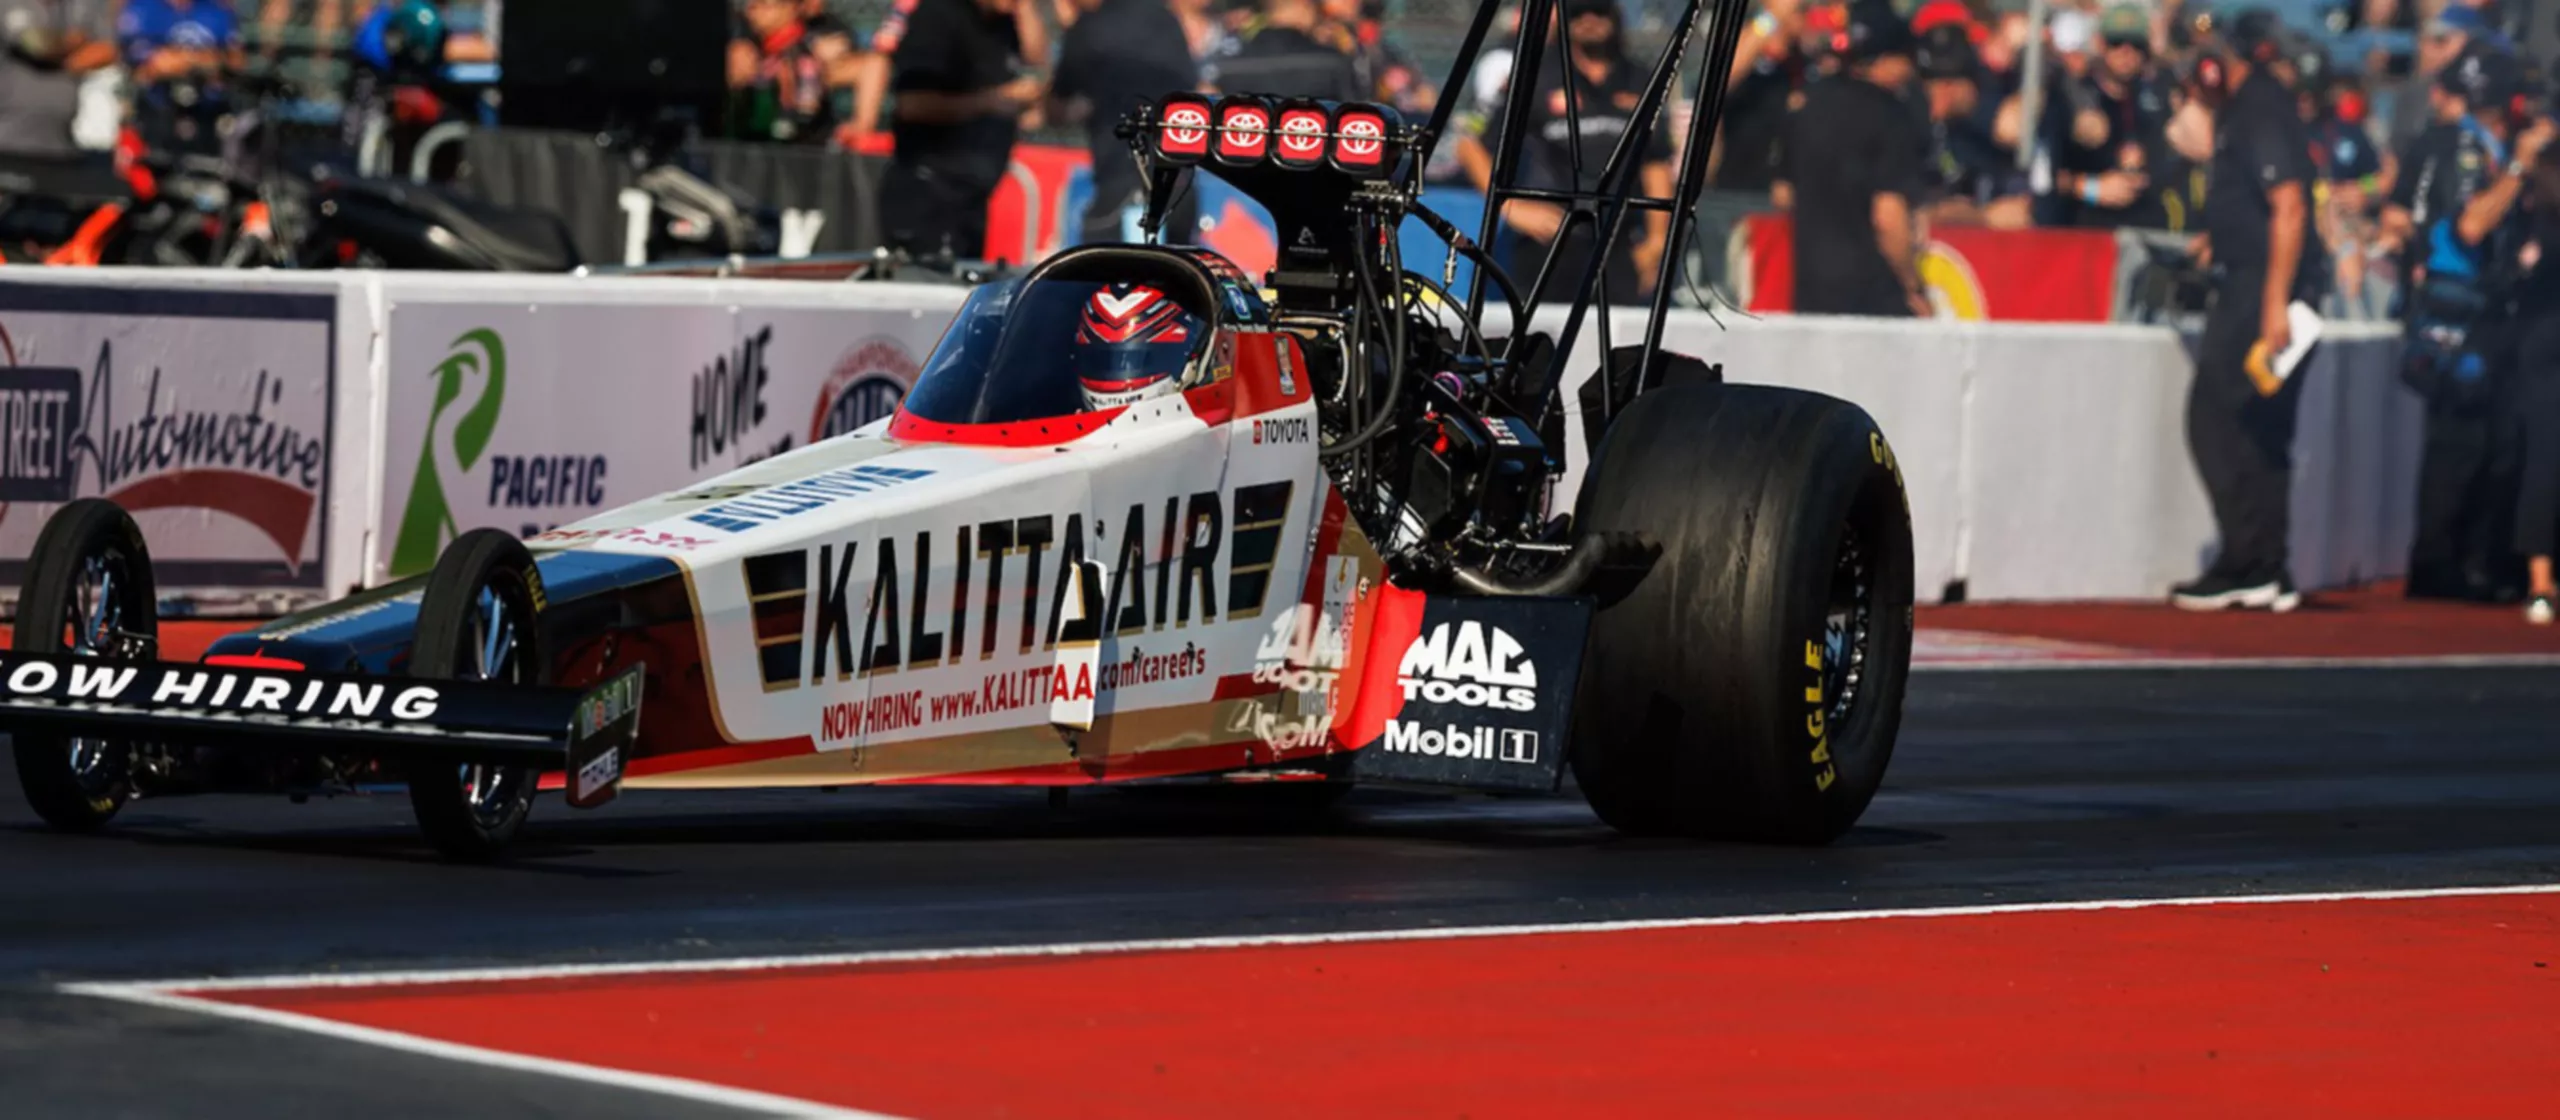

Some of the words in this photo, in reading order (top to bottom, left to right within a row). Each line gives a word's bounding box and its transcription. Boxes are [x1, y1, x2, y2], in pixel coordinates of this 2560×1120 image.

[69, 338, 322, 500] Automotive
[1263, 418, 1309, 444] TOYOTA
[488, 453, 607, 508] PACIFIC
[811, 512, 1107, 686] KALITTA
[1103, 490, 1223, 640] AIR
[1397, 620, 1538, 688] MAC
[0, 660, 138, 699] OW
[152, 670, 440, 720] HIRING
[822, 700, 863, 742] NOW
[864, 690, 923, 734] HIRING
[1397, 678, 1537, 713] TOOLS
[1805, 638, 1836, 792] EAGLE
[1384, 719, 1494, 759] Mobil
